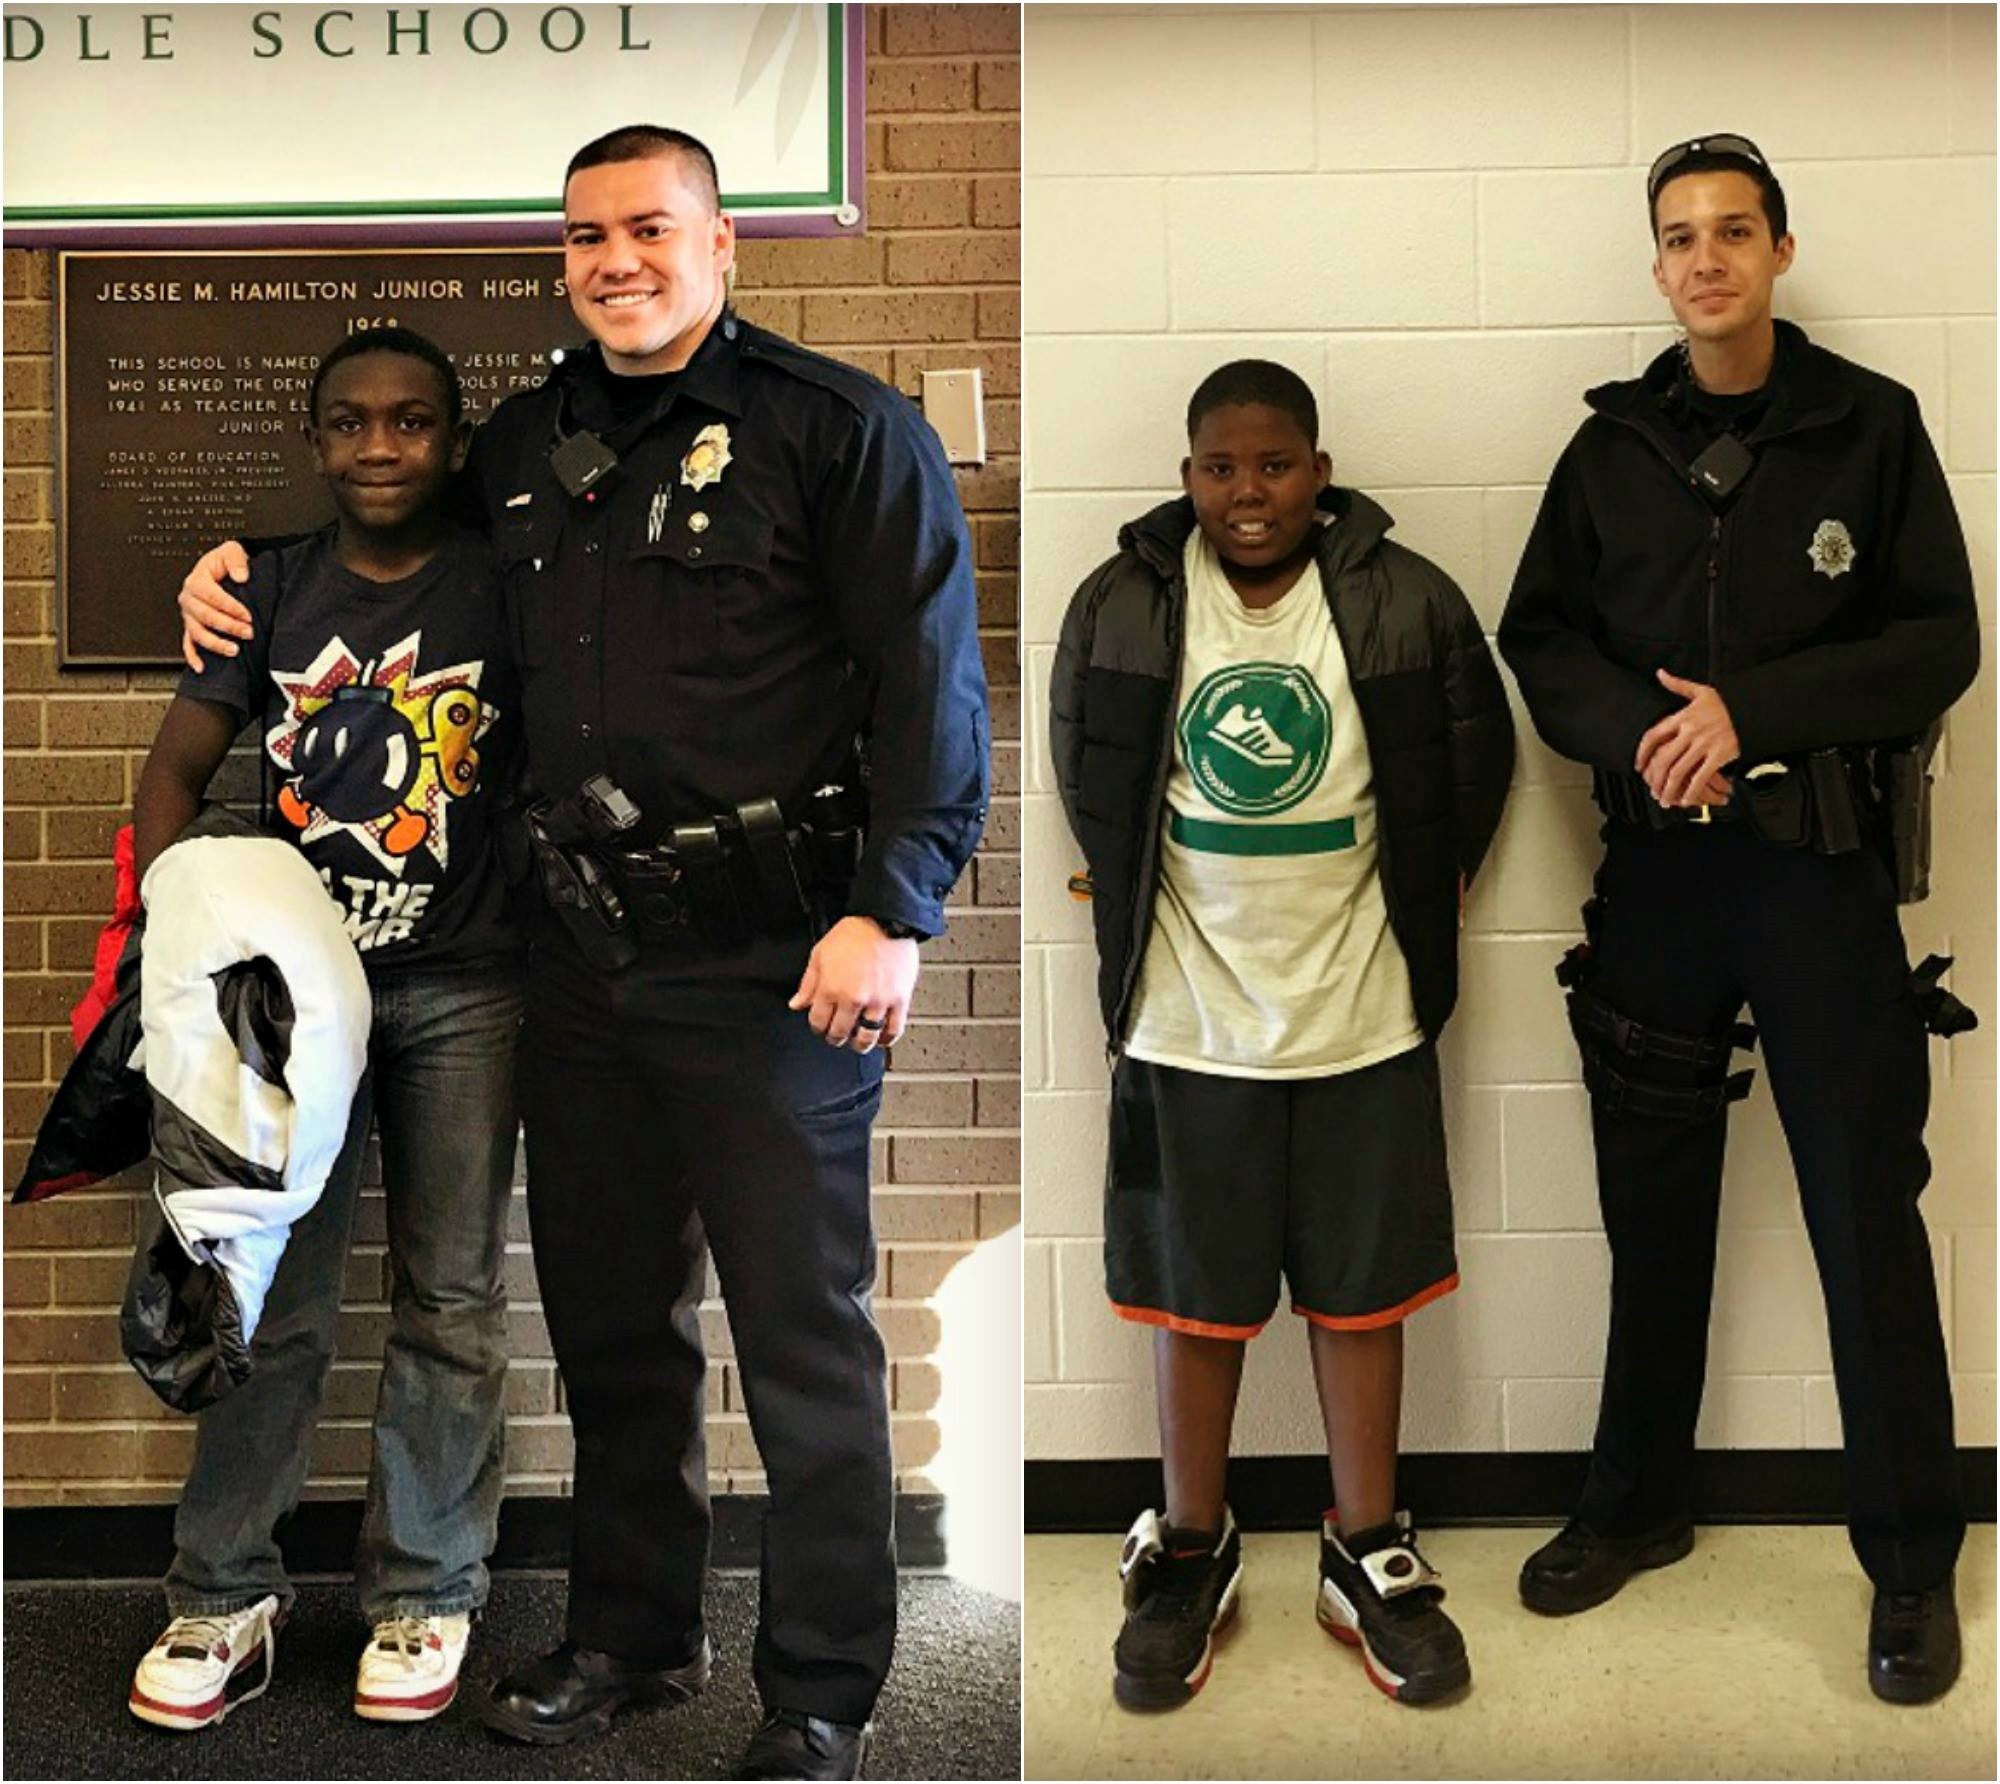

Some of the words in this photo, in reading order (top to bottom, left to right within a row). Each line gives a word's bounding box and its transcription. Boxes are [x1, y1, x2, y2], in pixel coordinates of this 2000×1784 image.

[4, 14, 175, 61] DLE
[252, 5, 651, 58] SCHOOL
[96, 282, 182, 302] JESSIE
[194, 282, 219, 301] M.
[230, 281, 357, 301] HAMILTON
[372, 279, 464, 299] JUNIOR
[483, 278, 540, 299] HIGH
[108, 357, 146, 371] THIS
[157, 356, 227, 371] SCHOOL
[236, 356, 253, 370] IS
[261, 356, 319, 370] NAMED
[464, 353, 521, 368] JESSIE
[107, 378, 145, 392] WHO
[157, 377, 224, 392] SERVED
[234, 377, 264, 391] THE
[107, 399, 146, 413] 1941
[159, 399, 182, 413] AS
[218, 421, 285, 435] JUNIOR
[108, 451, 157, 463] BOARD
[167, 451, 187, 463] OF
[197, 450, 281, 463] EDUCATION
[342, 874, 434, 919] THE
